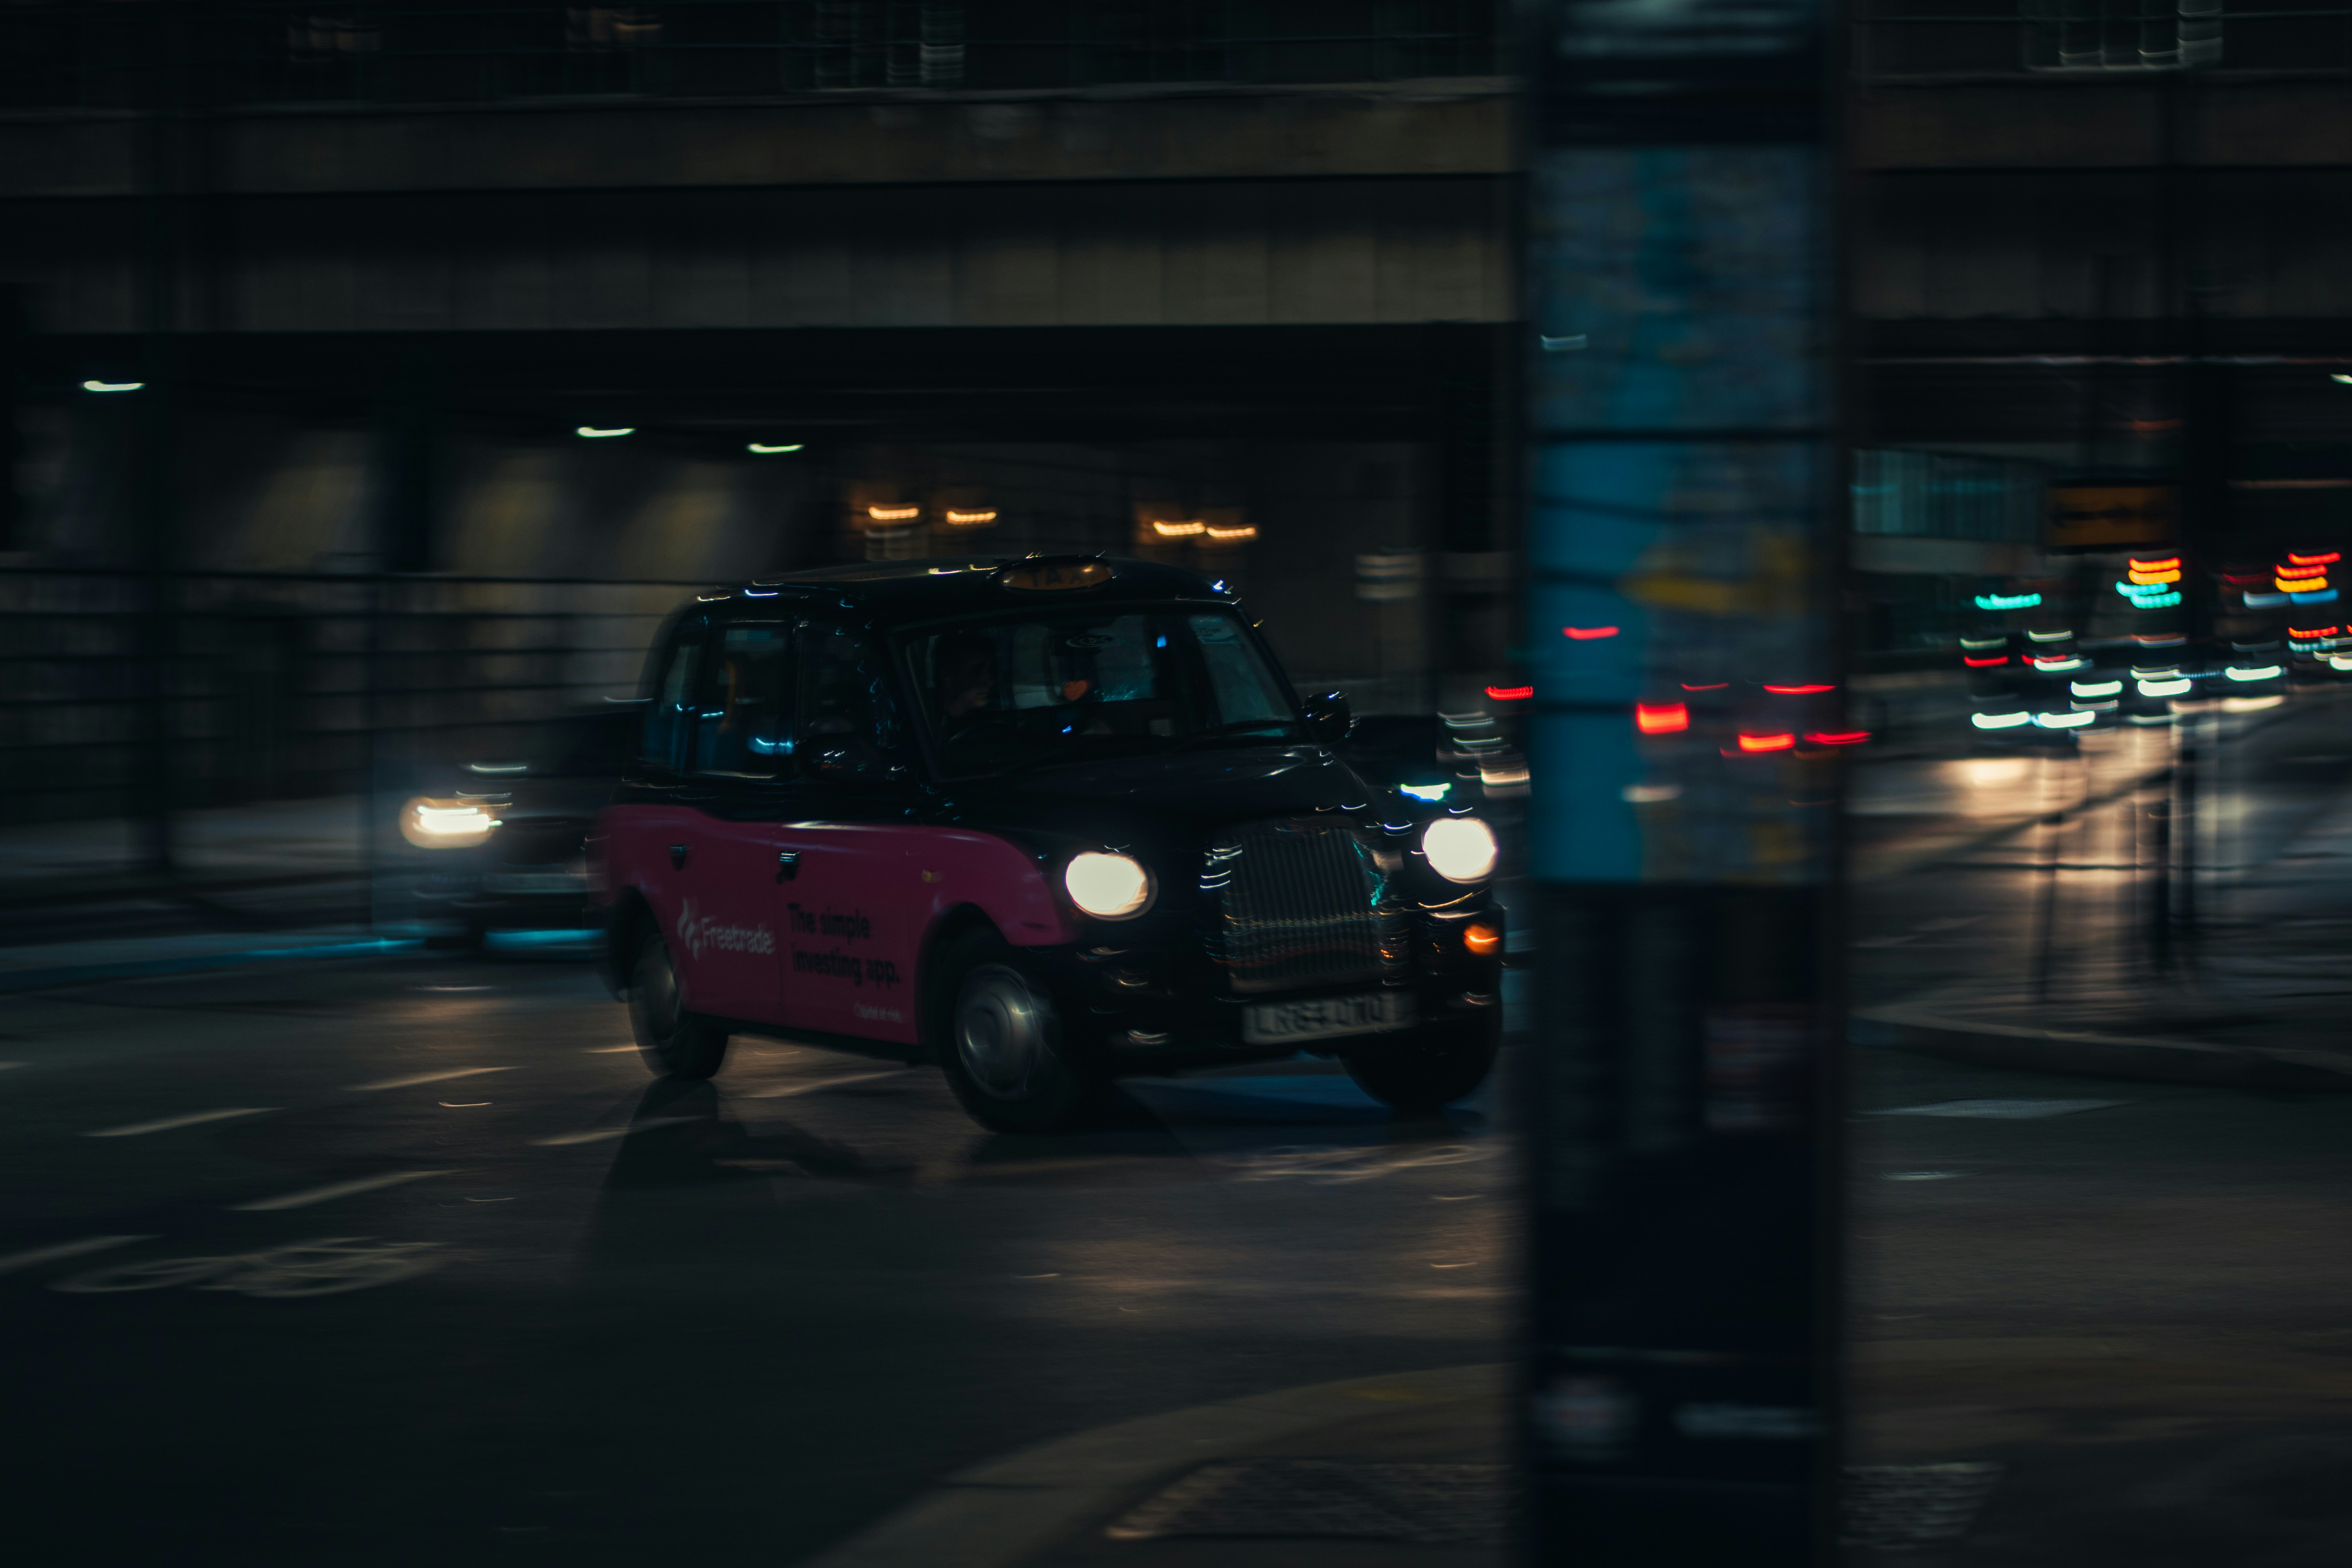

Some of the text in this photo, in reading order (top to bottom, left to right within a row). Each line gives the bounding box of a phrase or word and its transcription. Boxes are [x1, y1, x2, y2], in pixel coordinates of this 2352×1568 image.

[701, 916, 777, 955] Freetrade
[787, 903, 869, 945] The simple
[790, 942, 900, 990] investing app.
